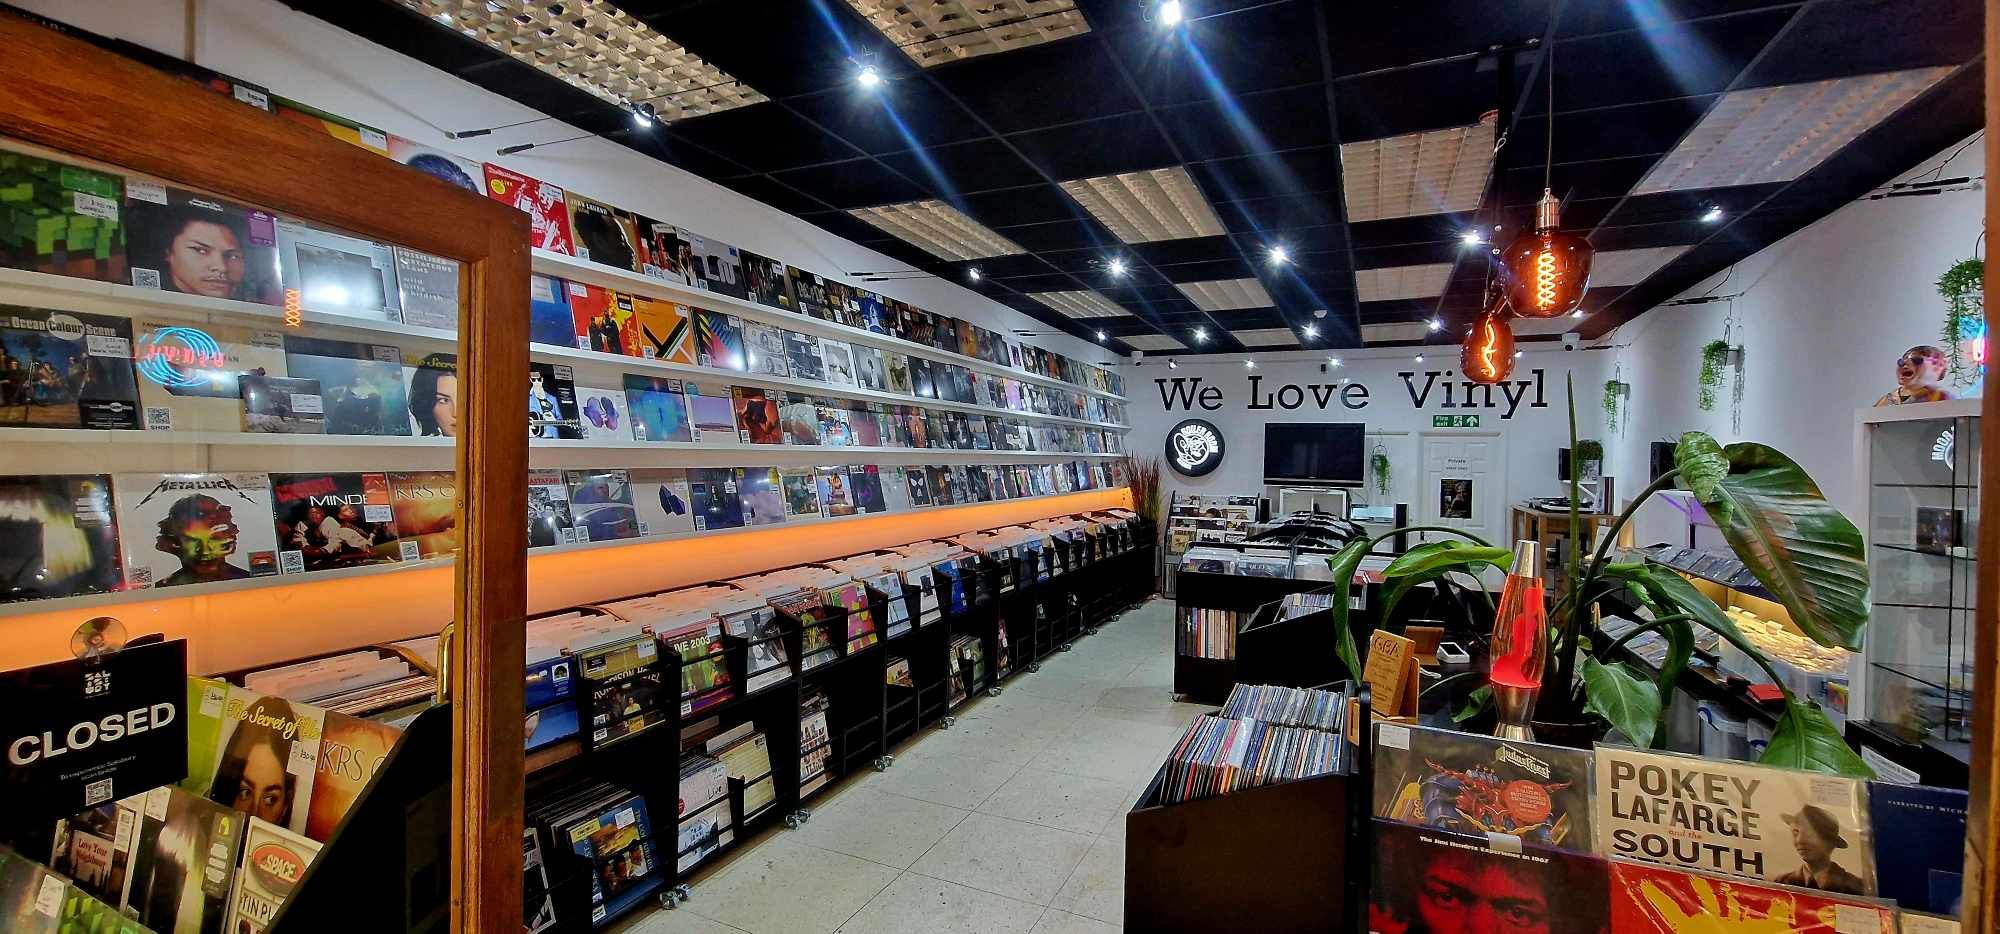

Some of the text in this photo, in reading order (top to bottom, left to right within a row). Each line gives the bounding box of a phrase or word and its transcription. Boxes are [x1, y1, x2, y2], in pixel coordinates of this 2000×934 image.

[1154, 369, 1548, 420] We Love Vinyl
[310, 494, 369, 507] MINDE
[394, 483, 434, 500] KRS
[690, 635, 711, 649] 2003
[226, 700, 249, 721] The
[248, 705, 286, 730] Secret
[283, 718, 302, 740] of
[8, 703, 176, 765] CLOSED
[320, 740, 364, 782] KRS
[1610, 760, 1761, 809] POKEY
[1612, 792, 1761, 840] LAFARGE
[1939, 806, 1969, 815] MICHA
[1420, 835, 1433, 843] The
[1668, 829, 1702, 840] and the
[1613, 829, 1763, 875] SOUTH
[262, 854, 298, 881] SPACE
[242, 894, 260, 917] TIN
